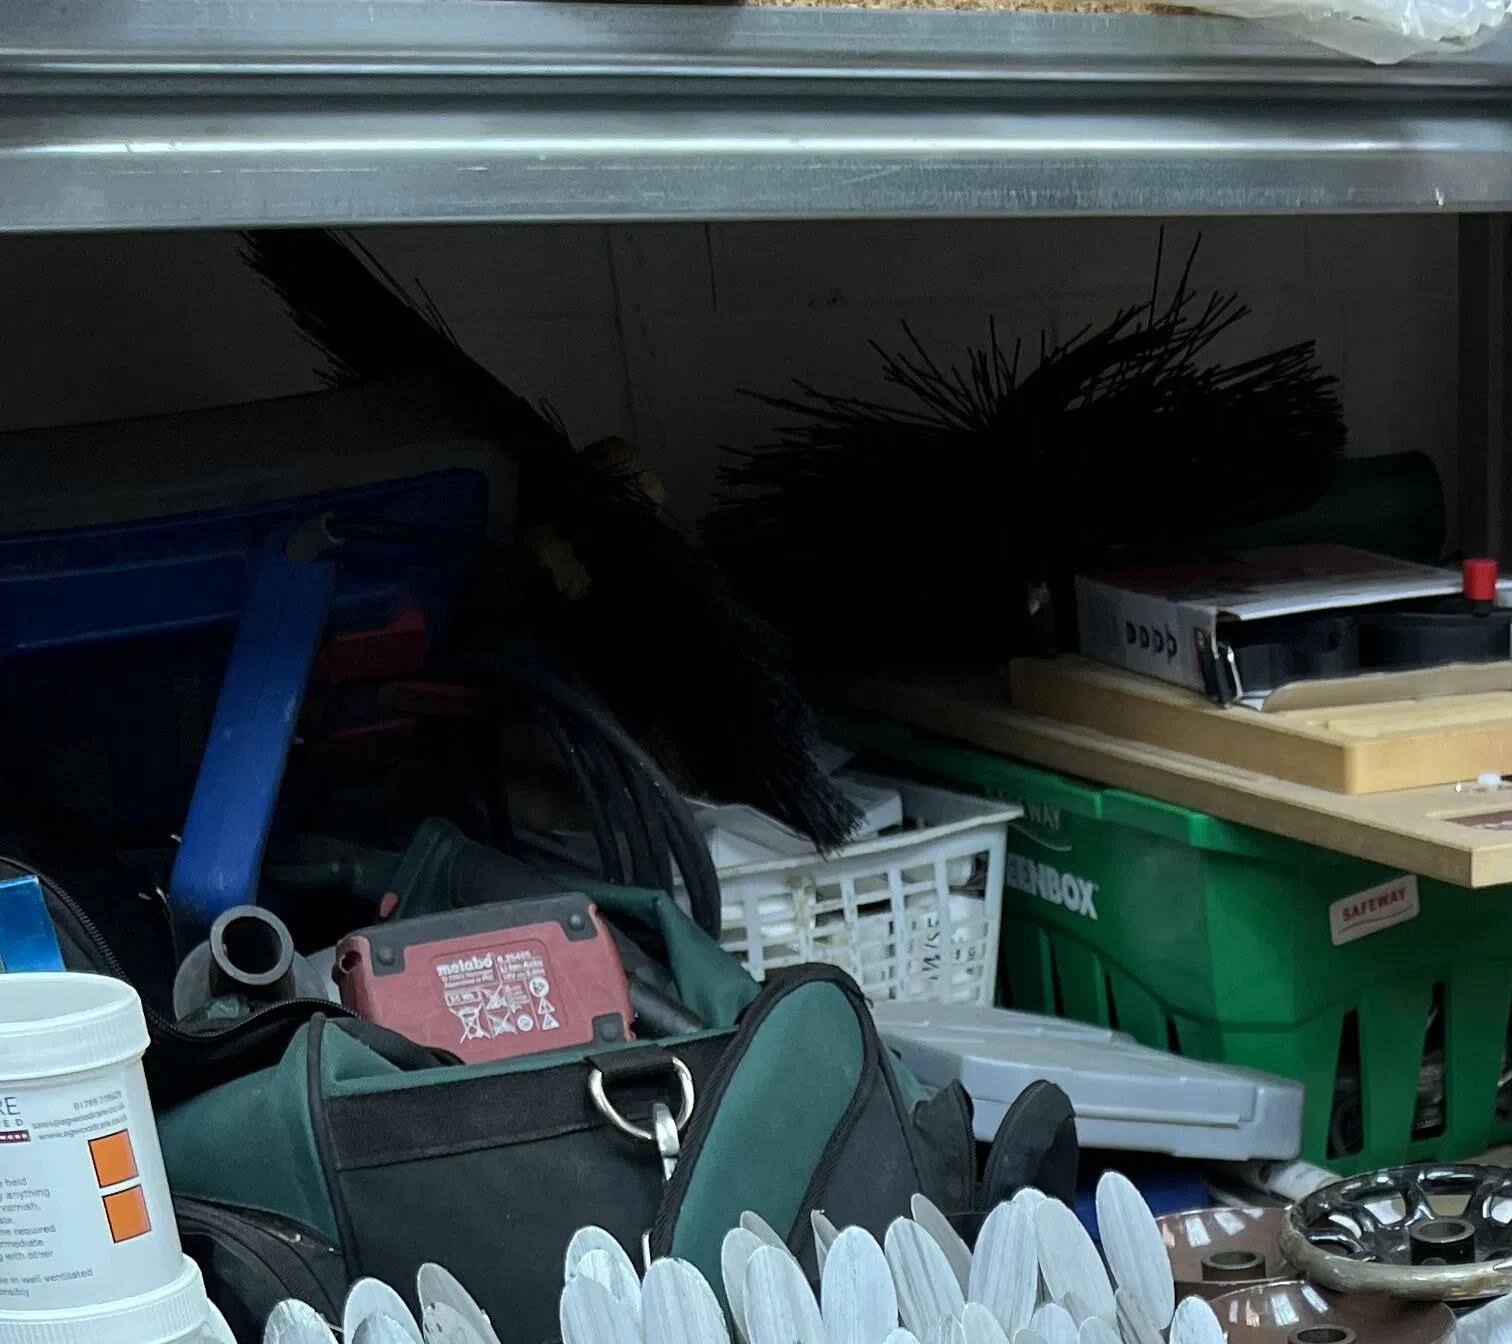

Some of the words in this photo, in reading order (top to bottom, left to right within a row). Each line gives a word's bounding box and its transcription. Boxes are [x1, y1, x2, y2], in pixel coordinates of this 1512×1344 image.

[1342, 885, 1406, 921] SAFEWAY
[436, 952, 493, 976] metabo
[6, 1188, 50, 1201] anything
[44, 1267, 94, 1283] ventilated
